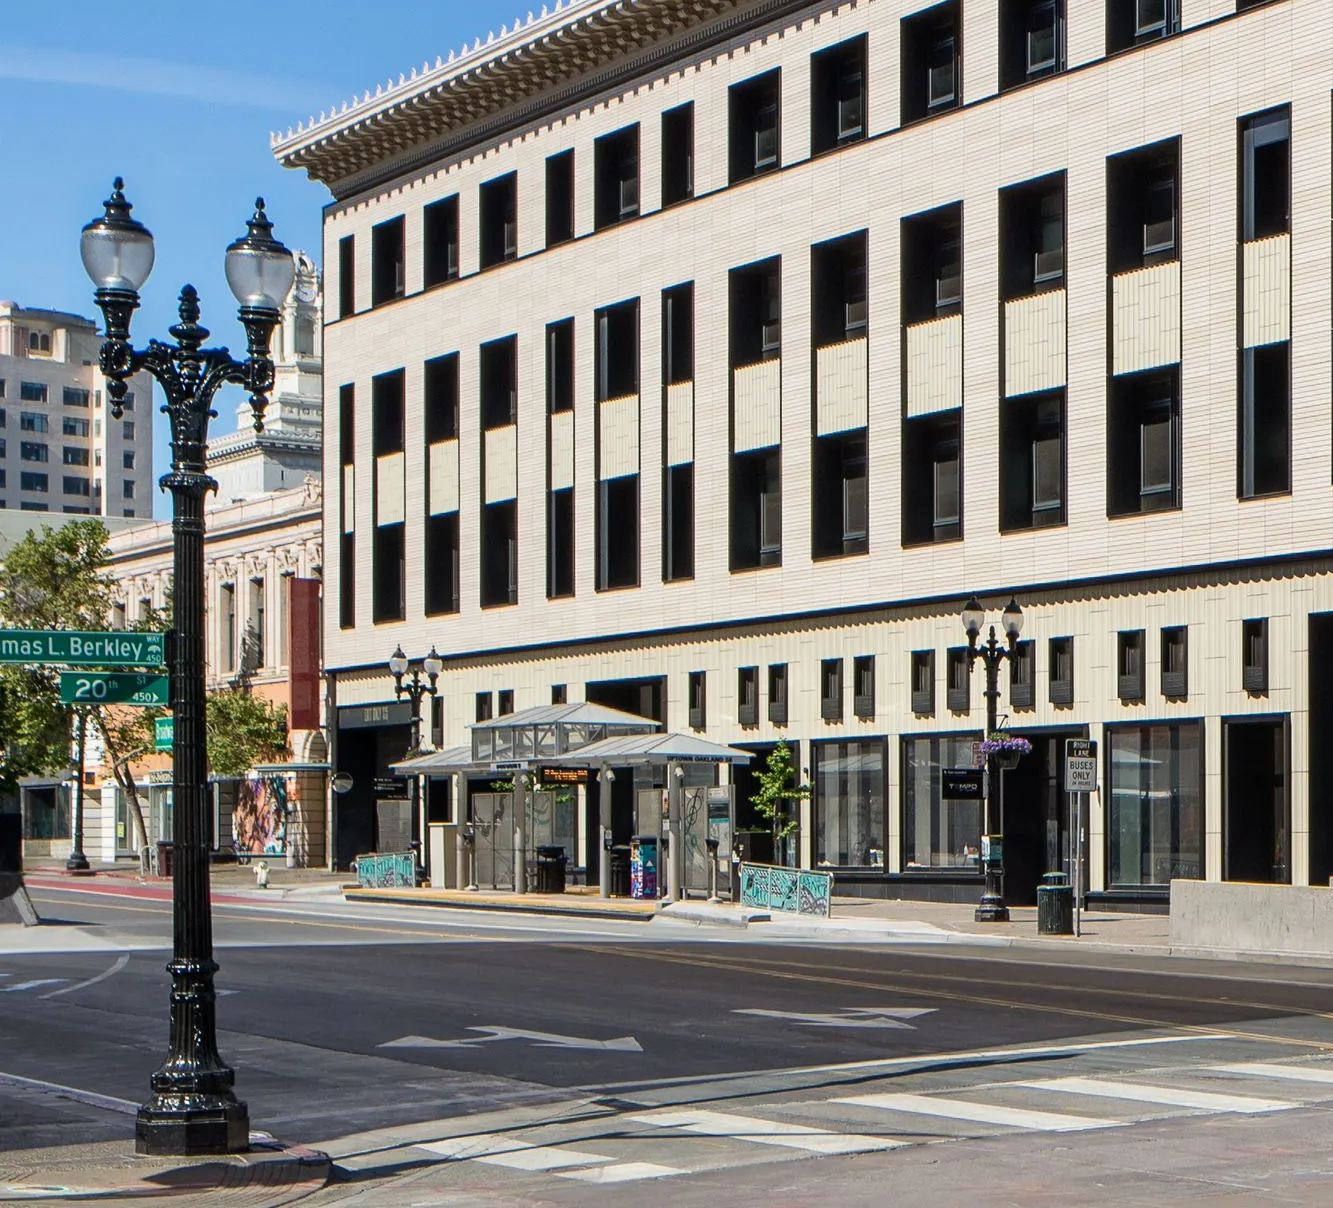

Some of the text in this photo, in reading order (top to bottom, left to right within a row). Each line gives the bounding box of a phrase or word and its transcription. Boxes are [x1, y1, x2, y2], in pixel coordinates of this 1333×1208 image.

[0, 635, 160, 662] mas L. Berkley WAY
[146, 654, 162, 663] 450
[75, 676, 147, 699] 20th ST
[133, 692, 151, 701] 450
[1073, 741, 1091, 749] RIGHT
[1073, 749, 1089, 757] LANE
[1069, 761, 1094, 770] BUSES
[1072, 772, 1090, 780] ONLY
